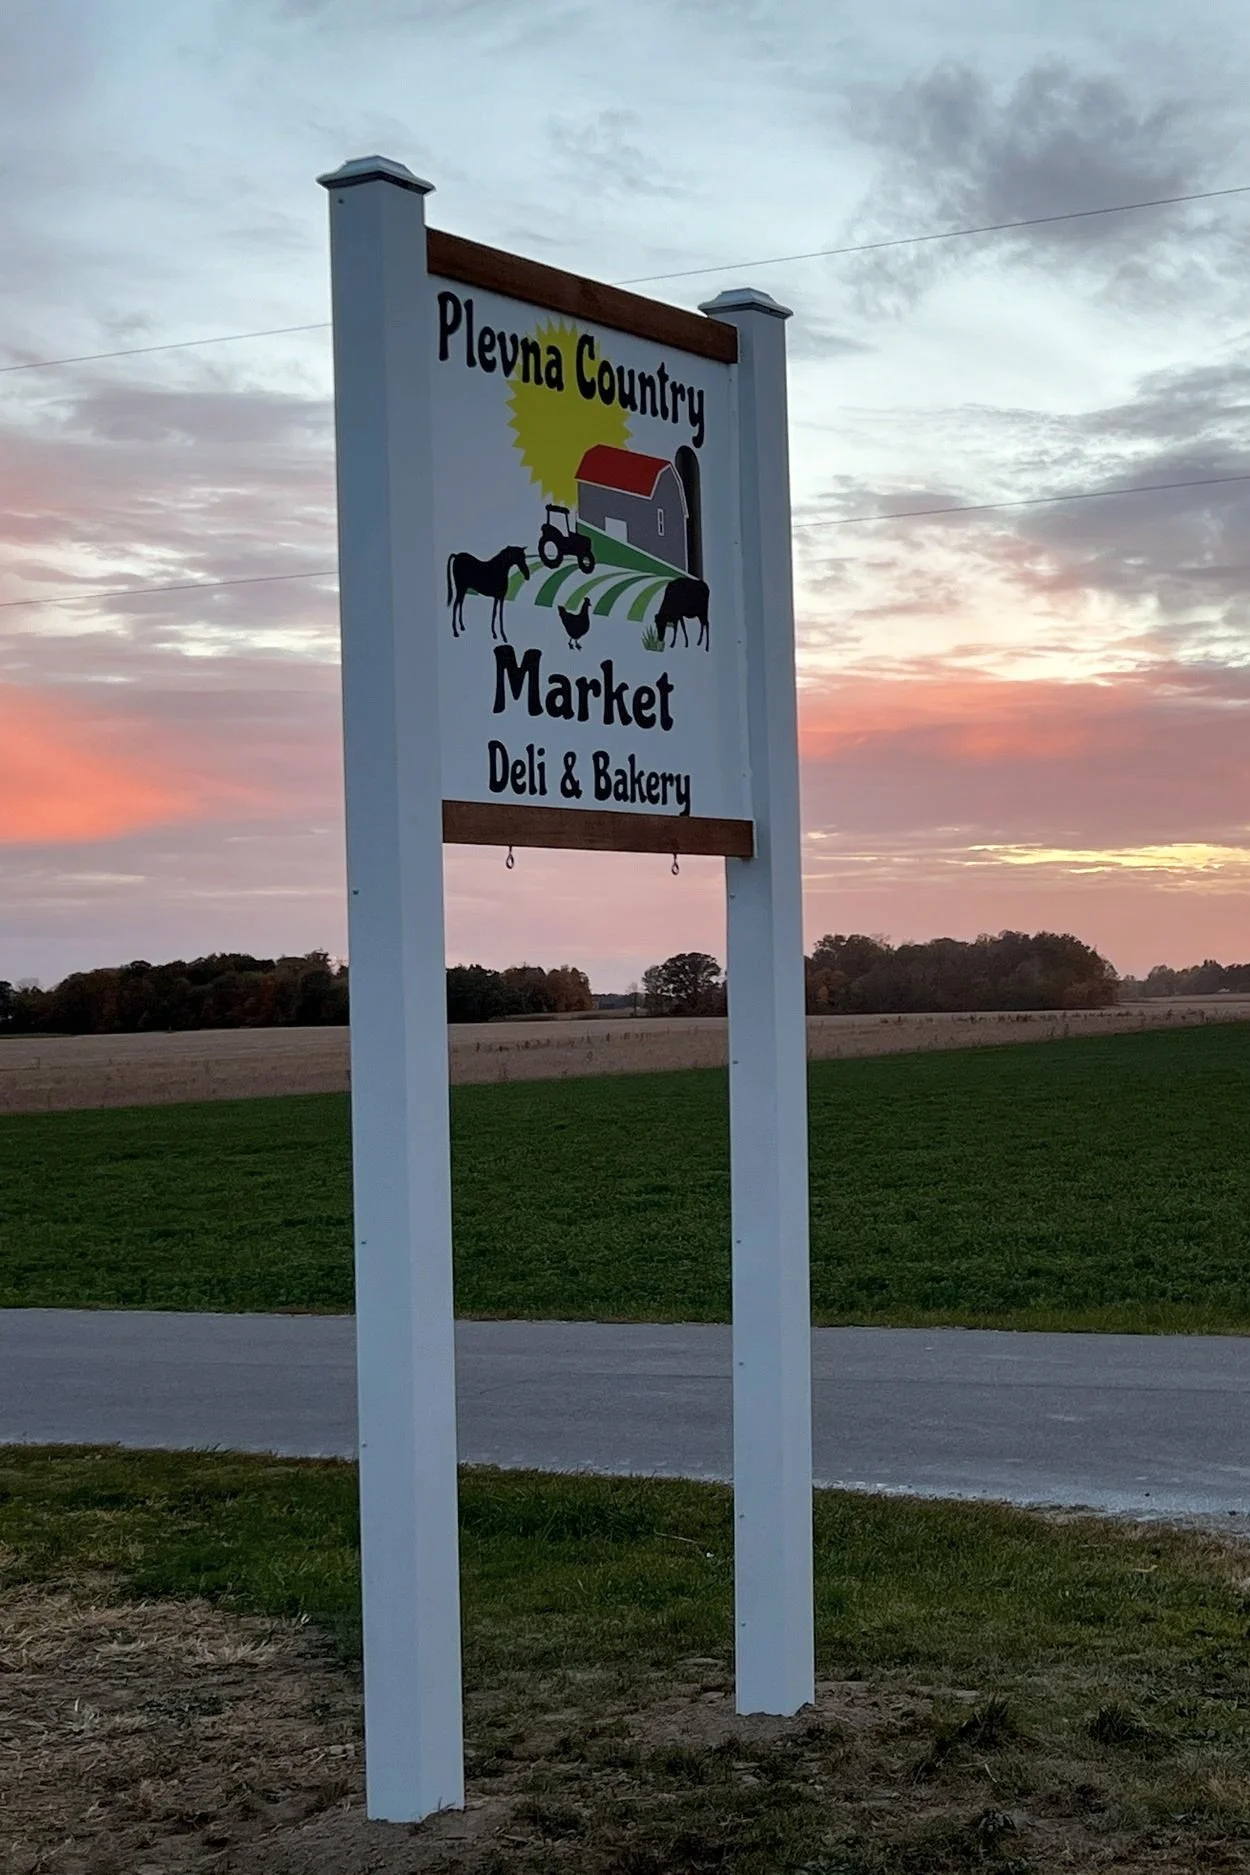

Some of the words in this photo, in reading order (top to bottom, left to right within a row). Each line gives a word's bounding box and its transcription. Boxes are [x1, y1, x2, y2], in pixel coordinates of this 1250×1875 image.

[437, 291, 564, 392] Plevna
[576, 334, 704, 449] Country
[493, 644, 674, 731] Market
[488, 740, 547, 796] Deli
[560, 751, 582, 799] &
[592, 750, 691, 817] Bakery
